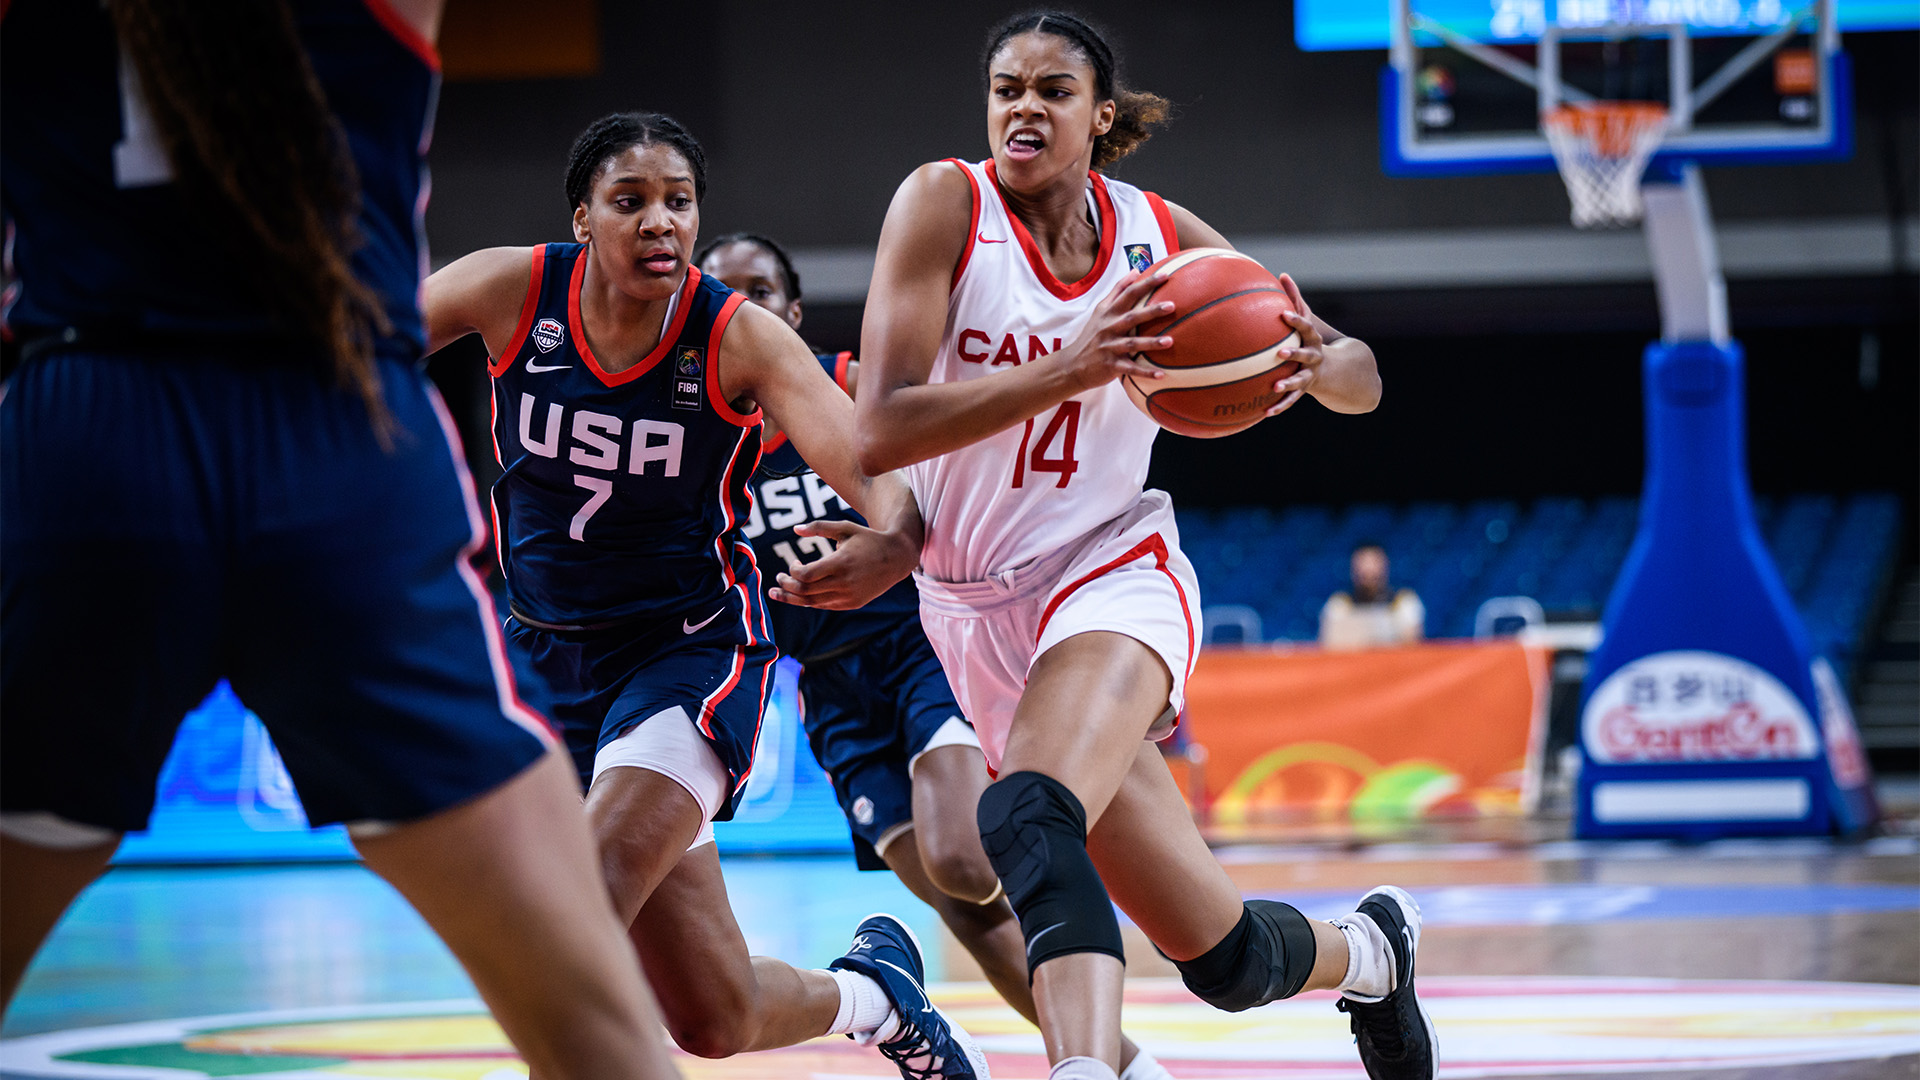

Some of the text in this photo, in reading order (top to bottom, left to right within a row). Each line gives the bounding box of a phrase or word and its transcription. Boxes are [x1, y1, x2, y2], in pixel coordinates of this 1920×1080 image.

[677, 381, 698, 394] FIBA
[519, 392, 685, 477] USA
[1011, 401, 1082, 488] 14
[569, 474, 613, 542] 7
